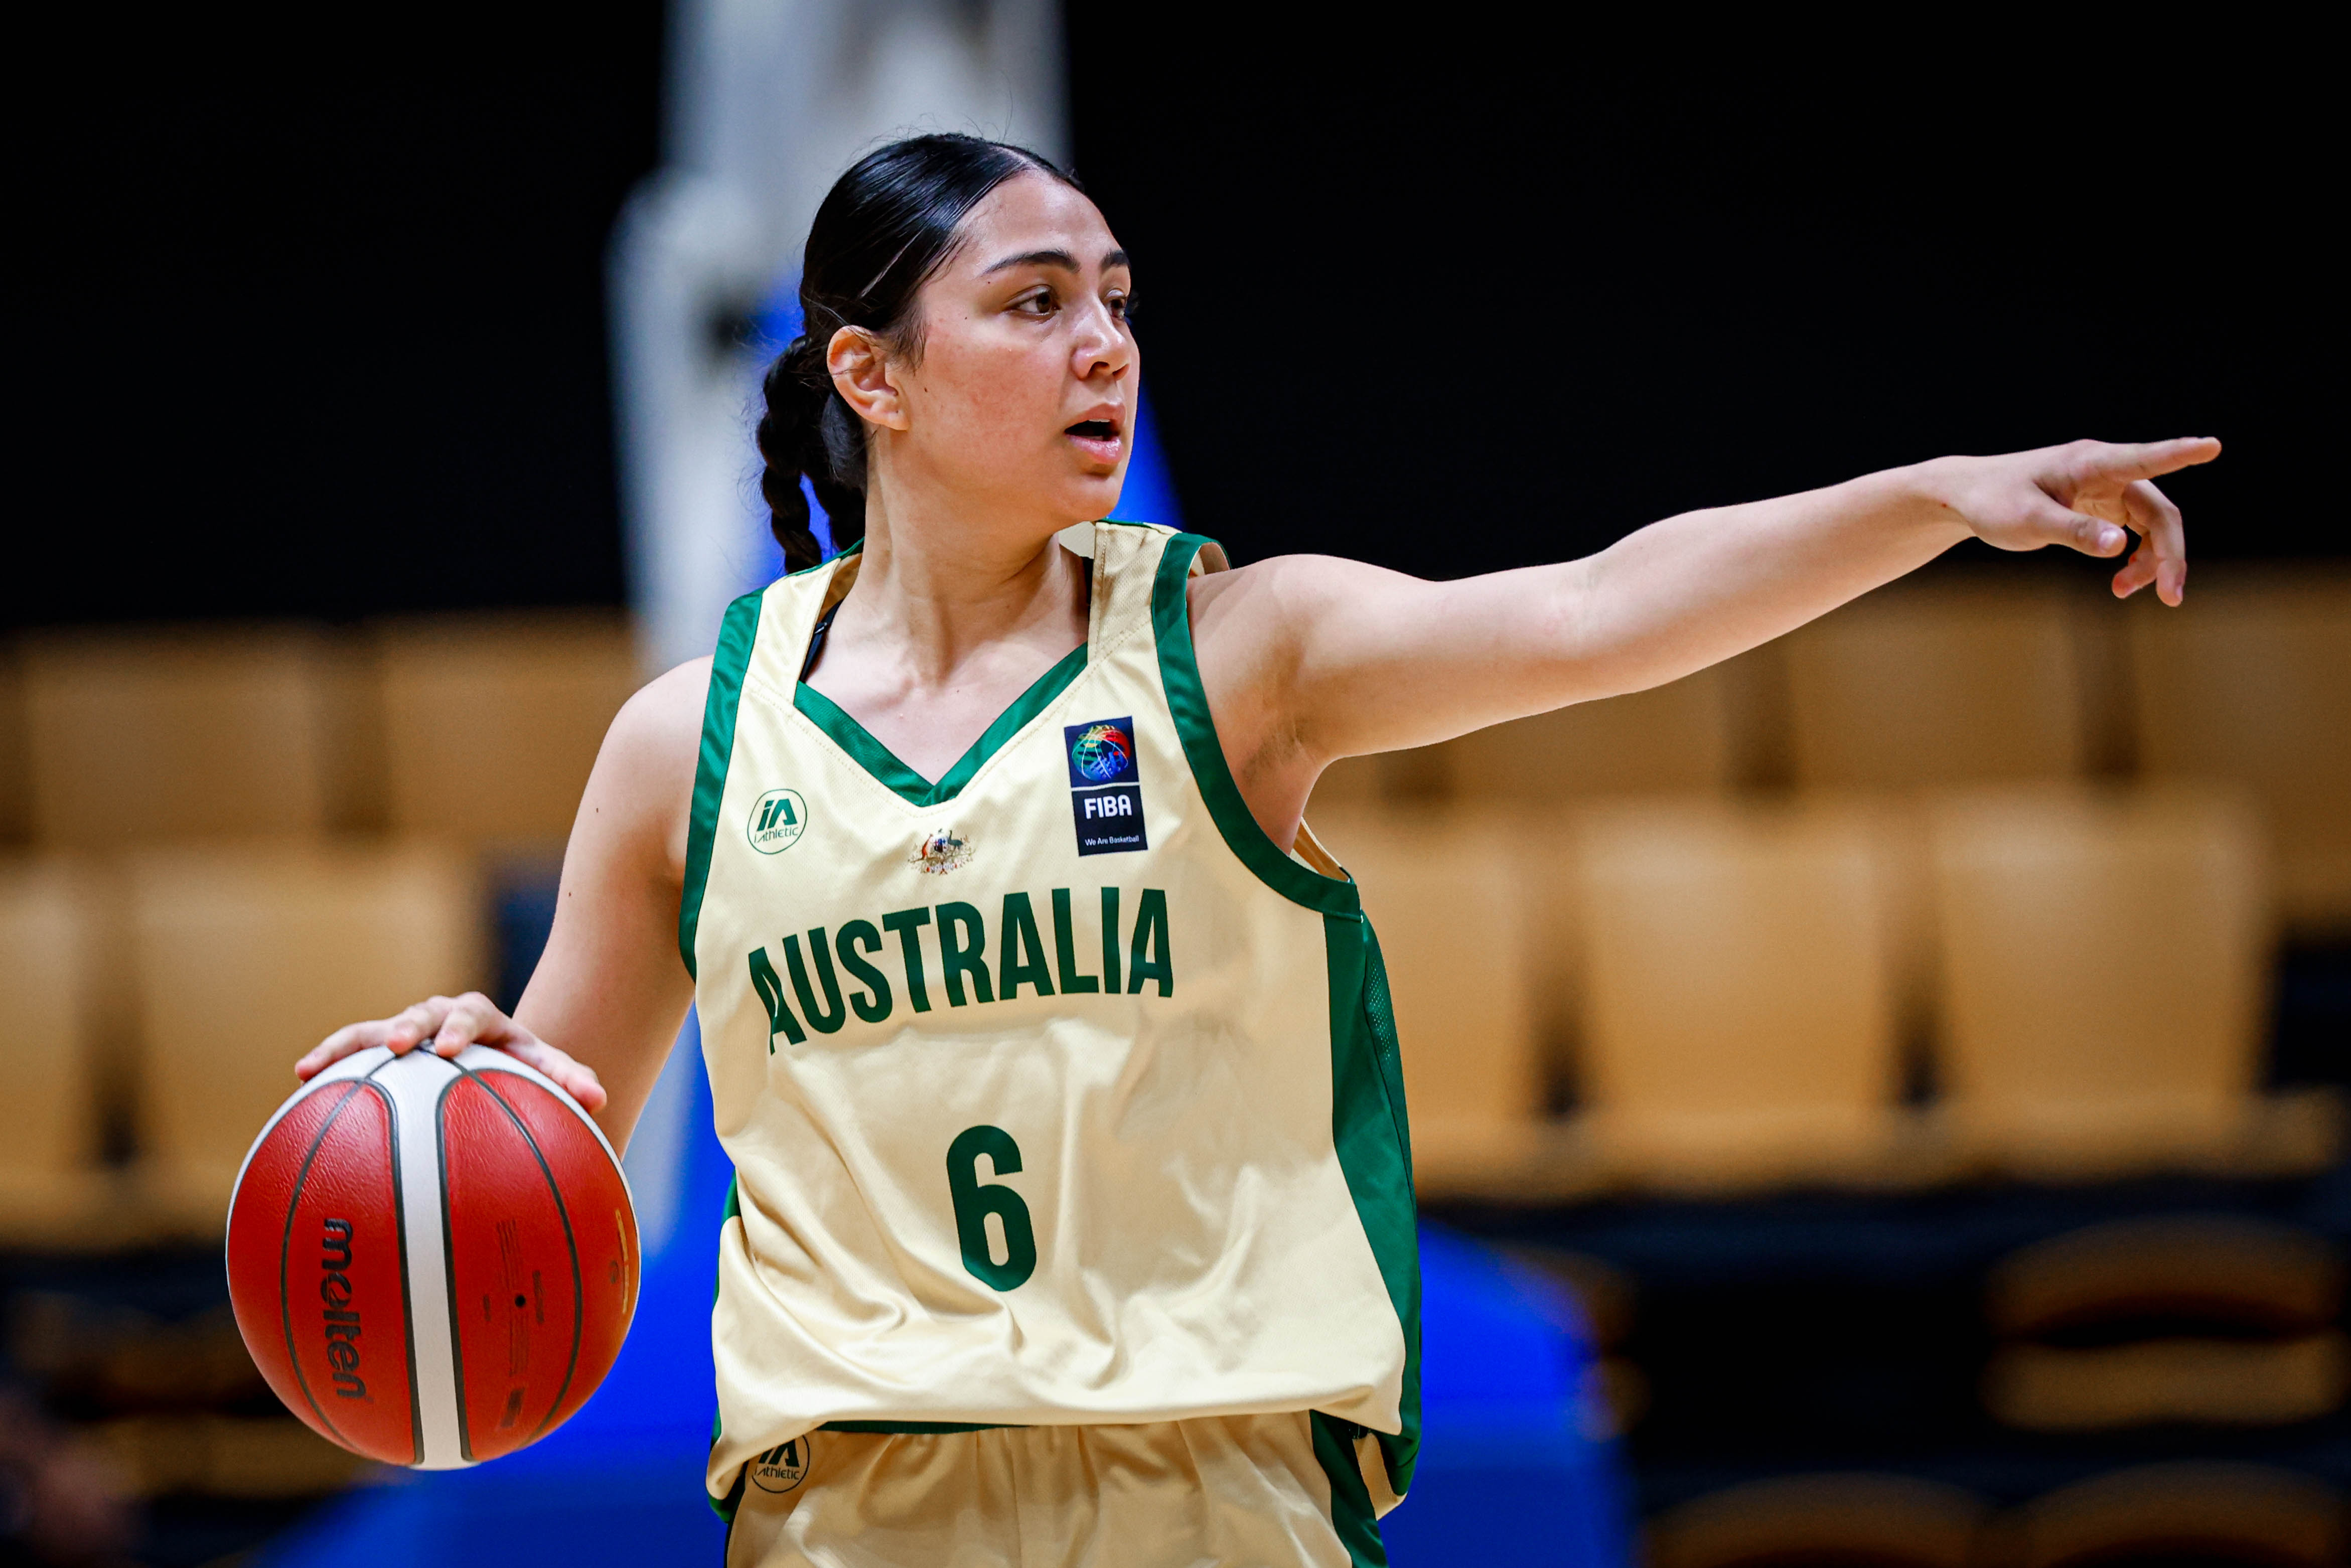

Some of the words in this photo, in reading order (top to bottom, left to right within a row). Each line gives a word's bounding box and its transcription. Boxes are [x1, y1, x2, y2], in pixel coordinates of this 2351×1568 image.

[1084, 794, 1132, 820] FIBA
[1085, 838, 1096, 846] We
[1109, 835, 1139, 844] Basketball
[747, 886, 1173, 1055] AUSTRALIA
[946, 1125, 1037, 1292] 6
[320, 1218, 367, 1399] molten
